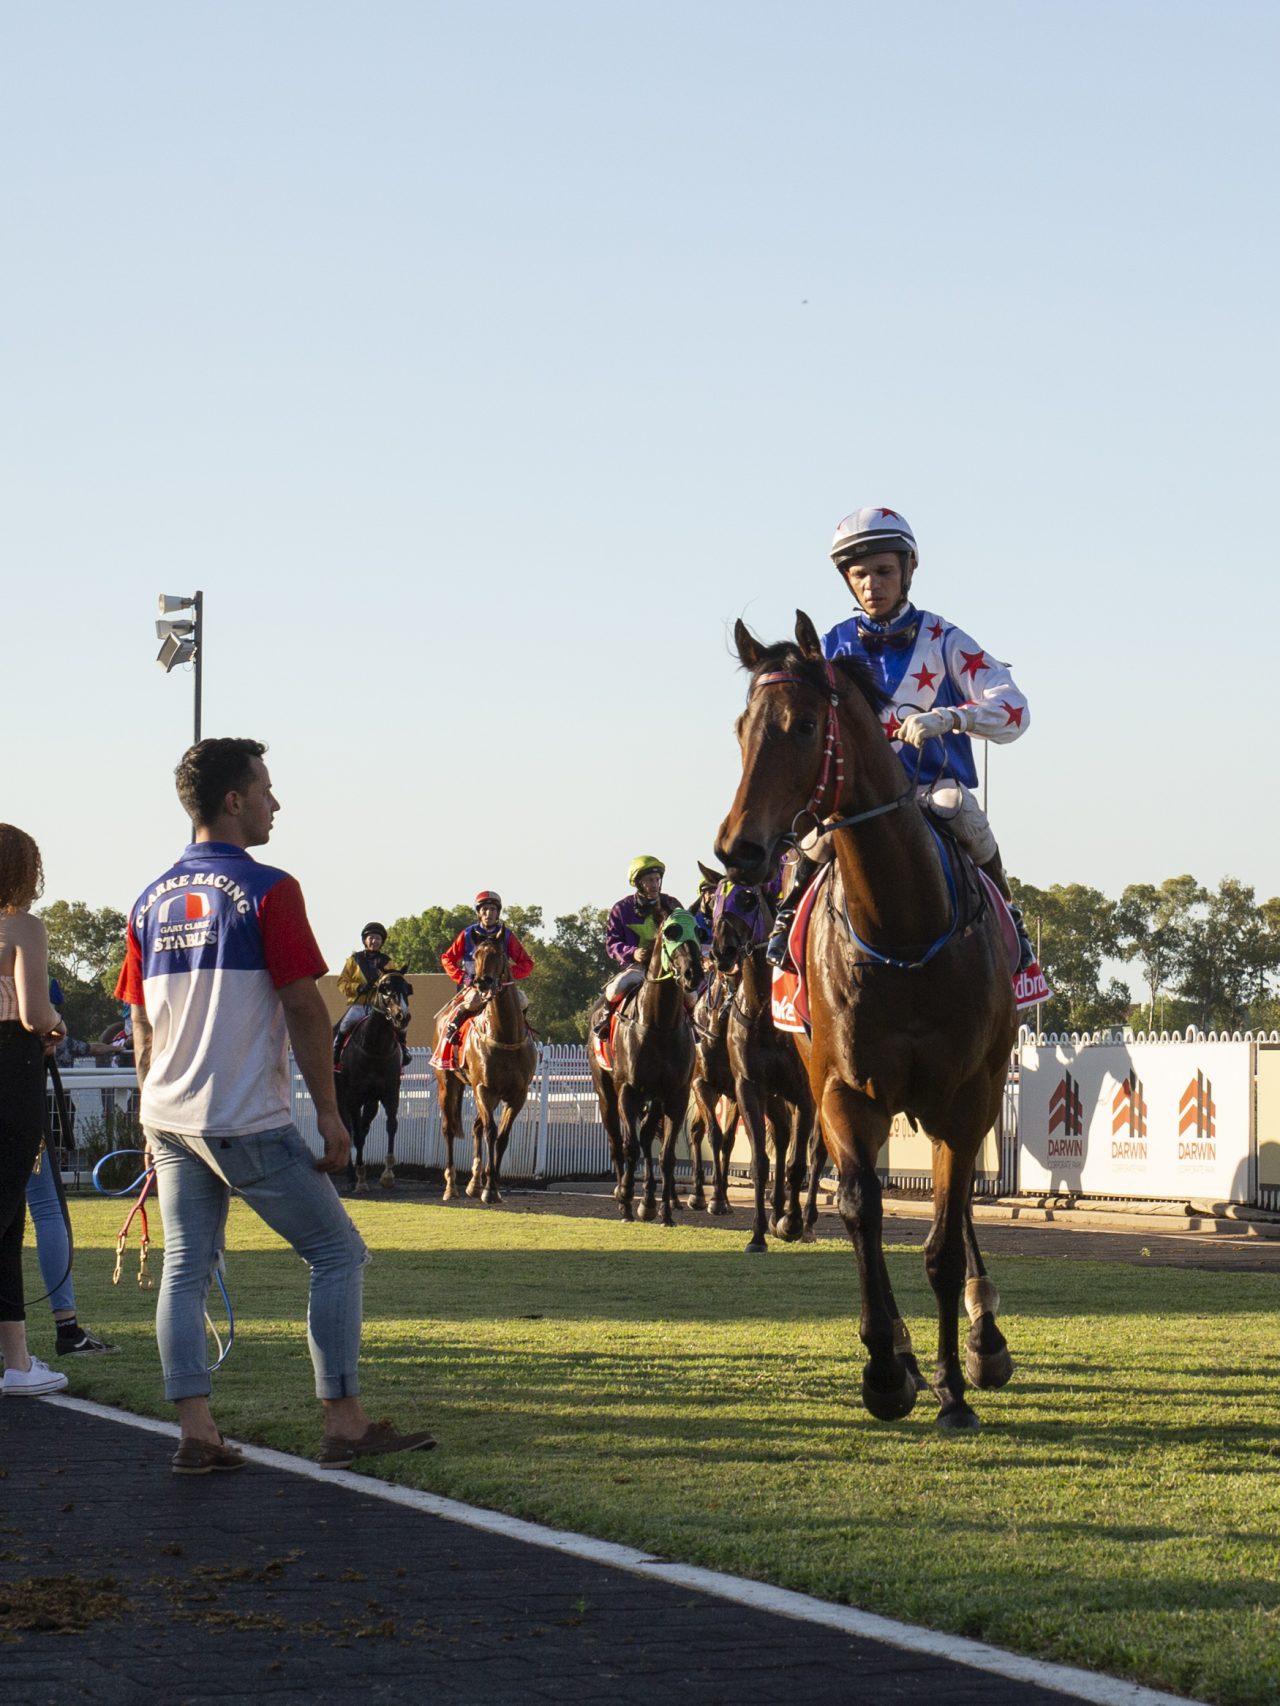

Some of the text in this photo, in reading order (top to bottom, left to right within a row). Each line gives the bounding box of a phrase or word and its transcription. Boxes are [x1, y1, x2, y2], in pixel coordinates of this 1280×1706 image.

[136, 872, 251, 929] CLARKE RACING
[160, 924, 183, 934] GARY
[1048, 1139, 1083, 1157] DARWIN
[1111, 1141, 1148, 1160] DARWIN
[1178, 1142, 1217, 1161] DARWIN
